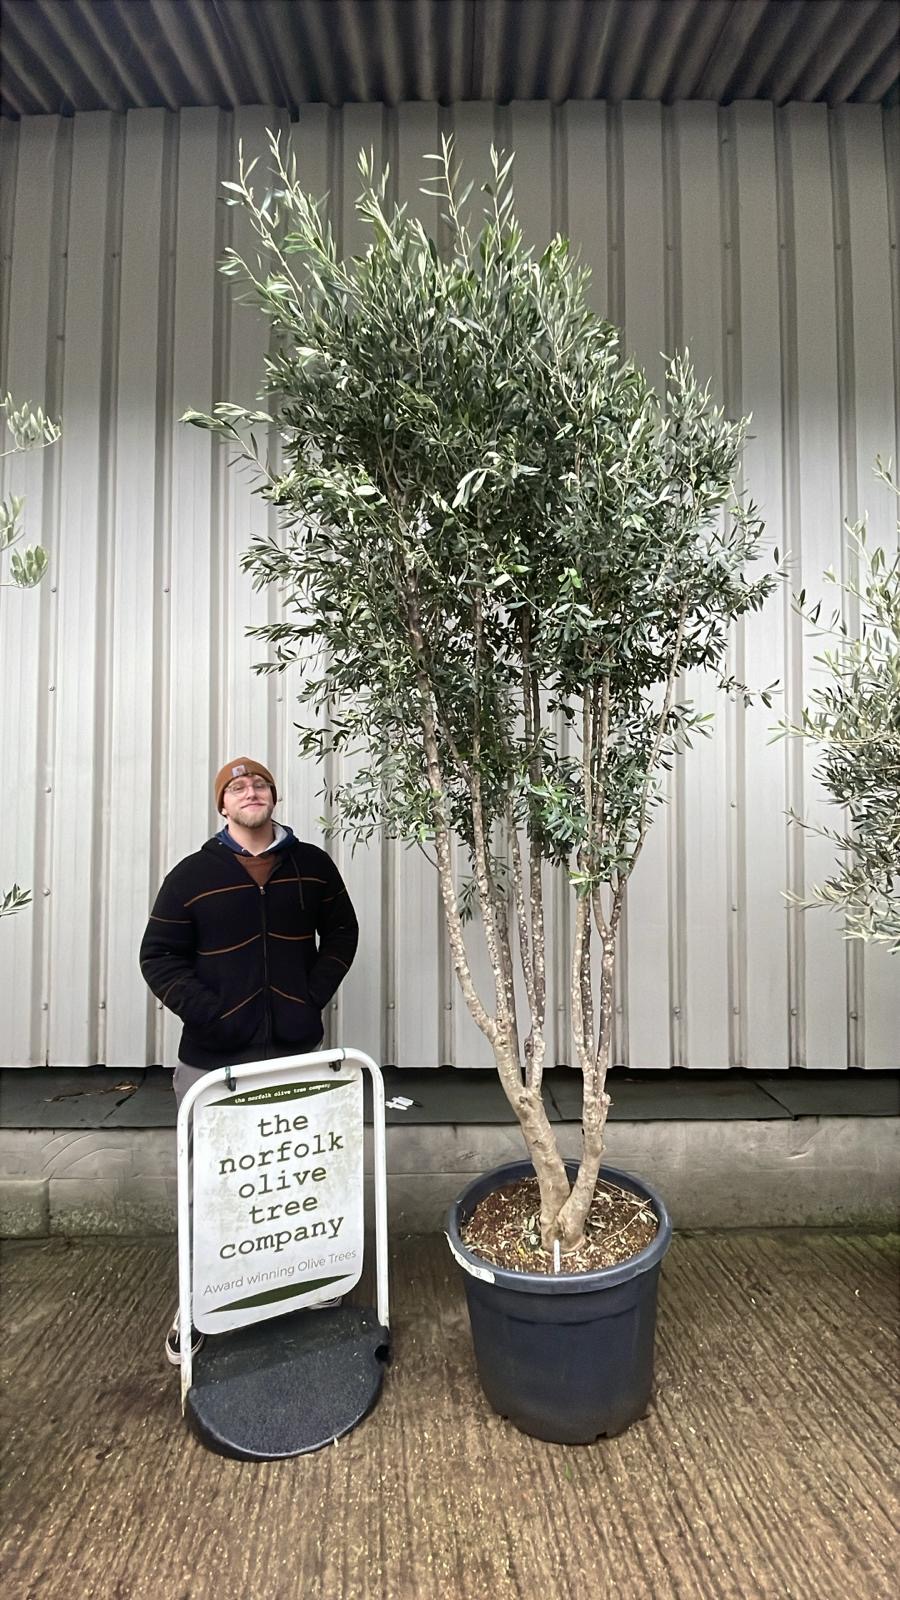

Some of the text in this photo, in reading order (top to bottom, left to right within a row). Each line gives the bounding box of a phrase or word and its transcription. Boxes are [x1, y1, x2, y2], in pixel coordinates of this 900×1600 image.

[248, 1093, 271, 1102] norfolk
[274, 1089, 291, 1097] olive
[257, 1114, 309, 1137] the
[219, 1132, 344, 1175] norfolk
[239, 1167, 327, 1199] olive
[249, 1198, 318, 1224] tree
[219, 1216, 344, 1260] company
[204, 1249, 357, 1296] Award winning Olive Trees
